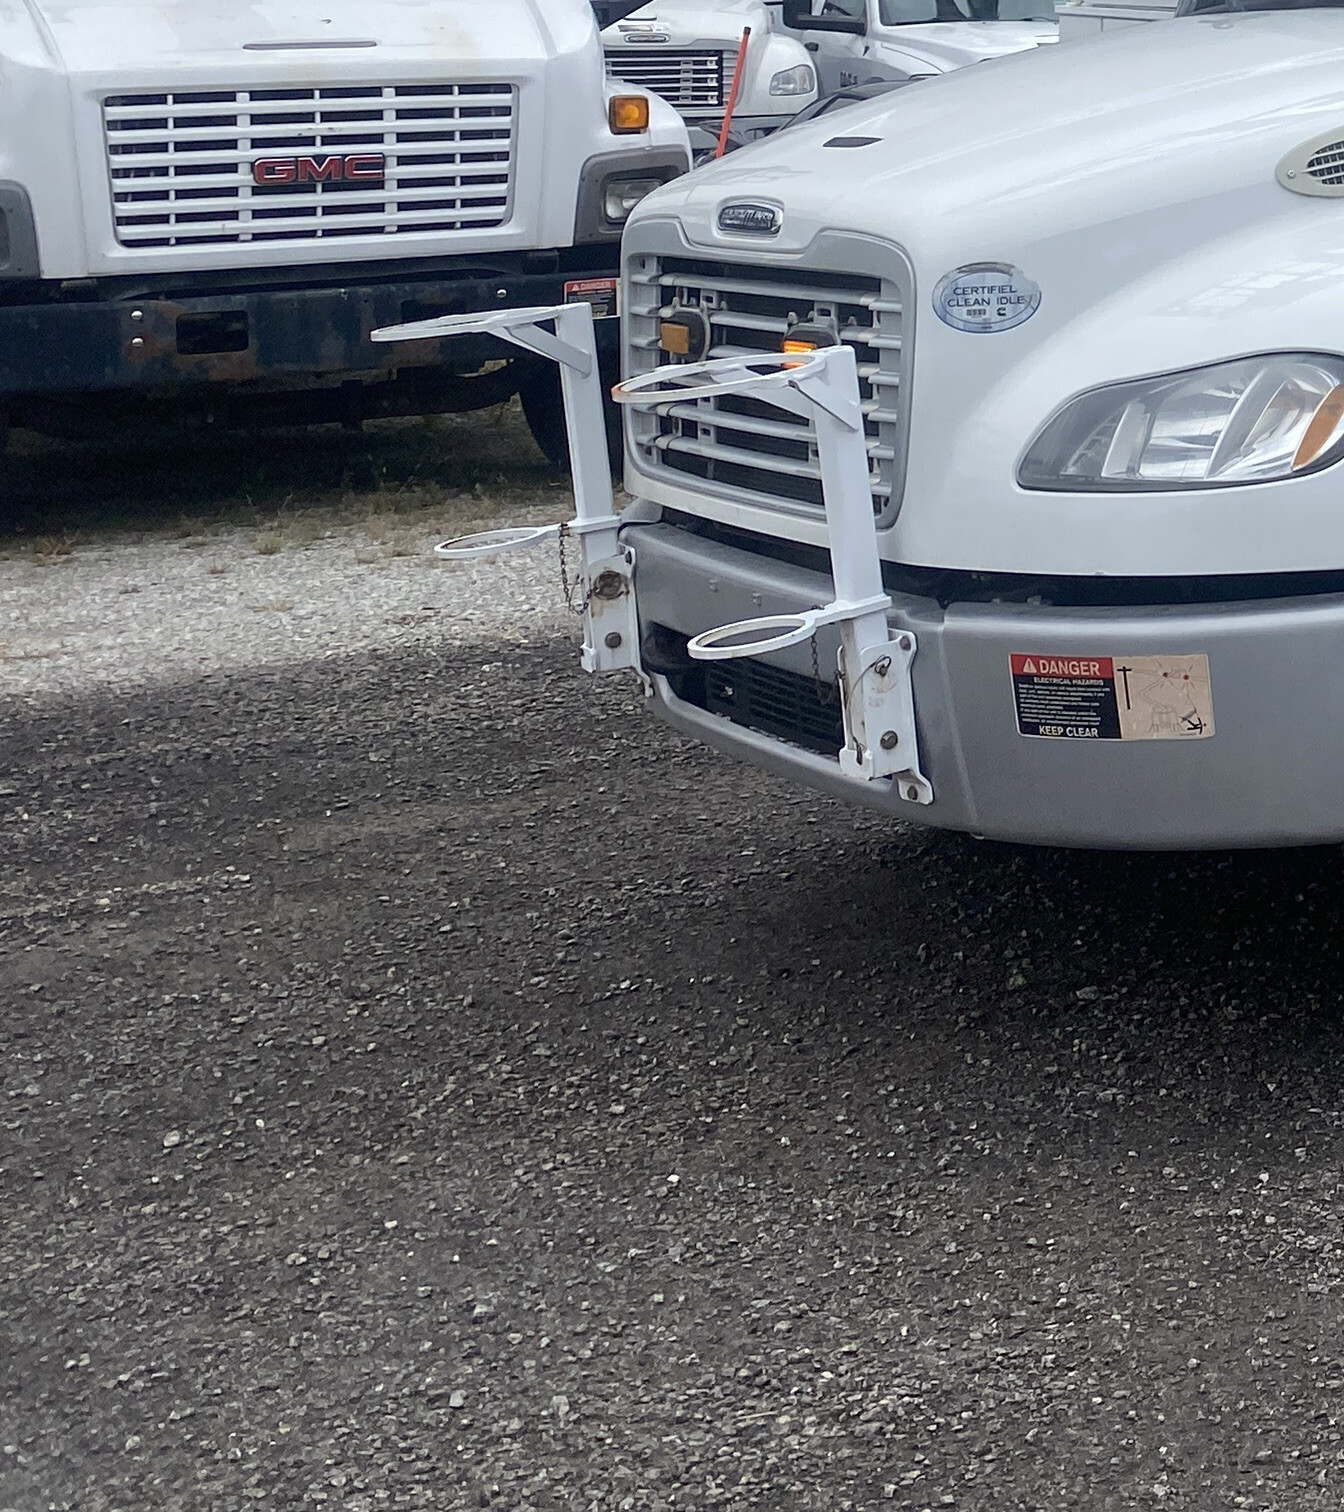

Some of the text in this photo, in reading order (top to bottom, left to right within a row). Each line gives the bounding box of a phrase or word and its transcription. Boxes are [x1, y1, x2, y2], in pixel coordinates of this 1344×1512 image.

[253, 153, 384, 184] GMC
[947, 295, 1025, 308] CLEAN IDLE
[1039, 659, 1100, 676] DANGER
[1033, 676, 1072, 685] ELECTRICAL
[1039, 725, 1099, 738] KEEP CLEAR
